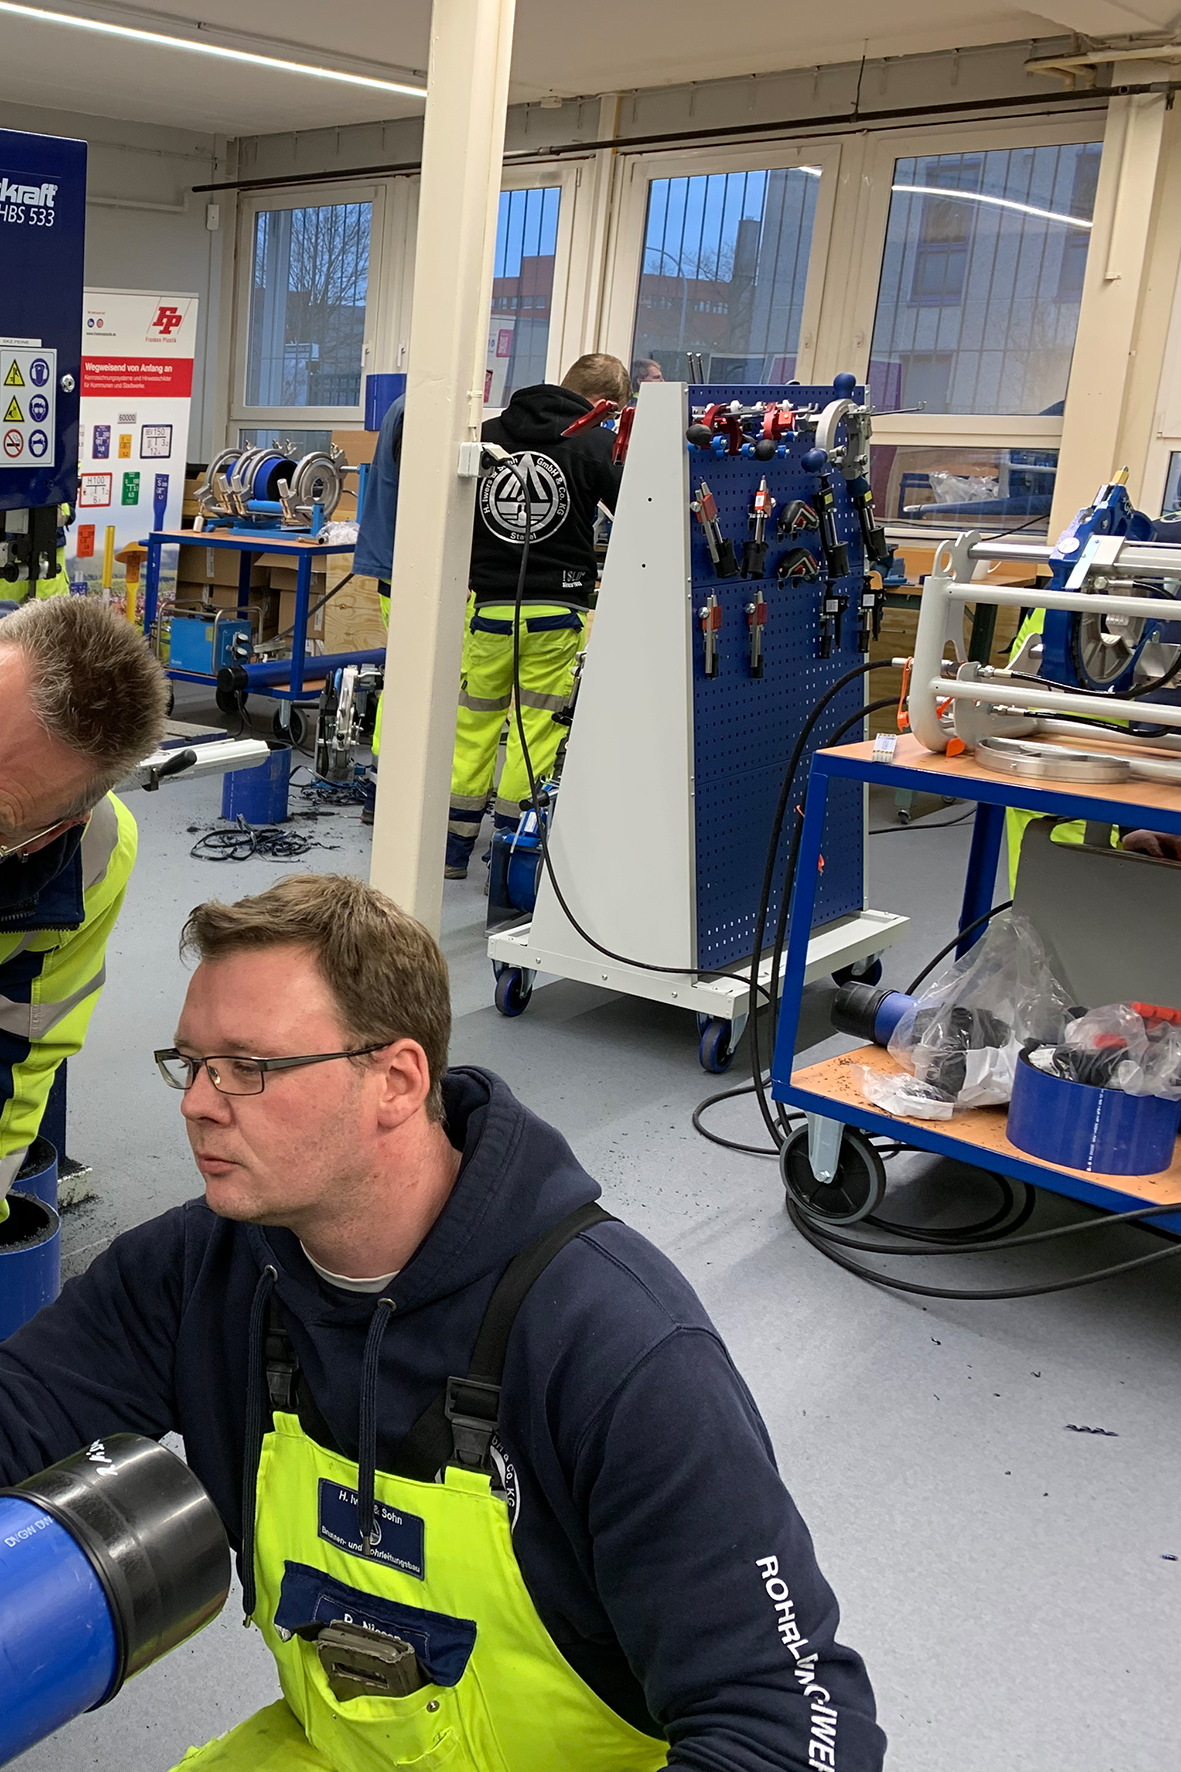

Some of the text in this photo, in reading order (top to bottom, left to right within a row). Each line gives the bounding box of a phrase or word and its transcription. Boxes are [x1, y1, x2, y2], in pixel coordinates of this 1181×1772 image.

[29, 209, 55, 227] 533
[85, 362, 126, 373] Wegweisend
[140, 364, 163, 374] Anfang
[536, 458, 560, 476] GmbH
[556, 502, 567, 516] KG
[338, 1490, 348, 1502] H.
[381, 1508, 403, 1525] Sohn
[4, 1525, 36, 1548] DVGW
[348, 1541, 362, 1552] und
